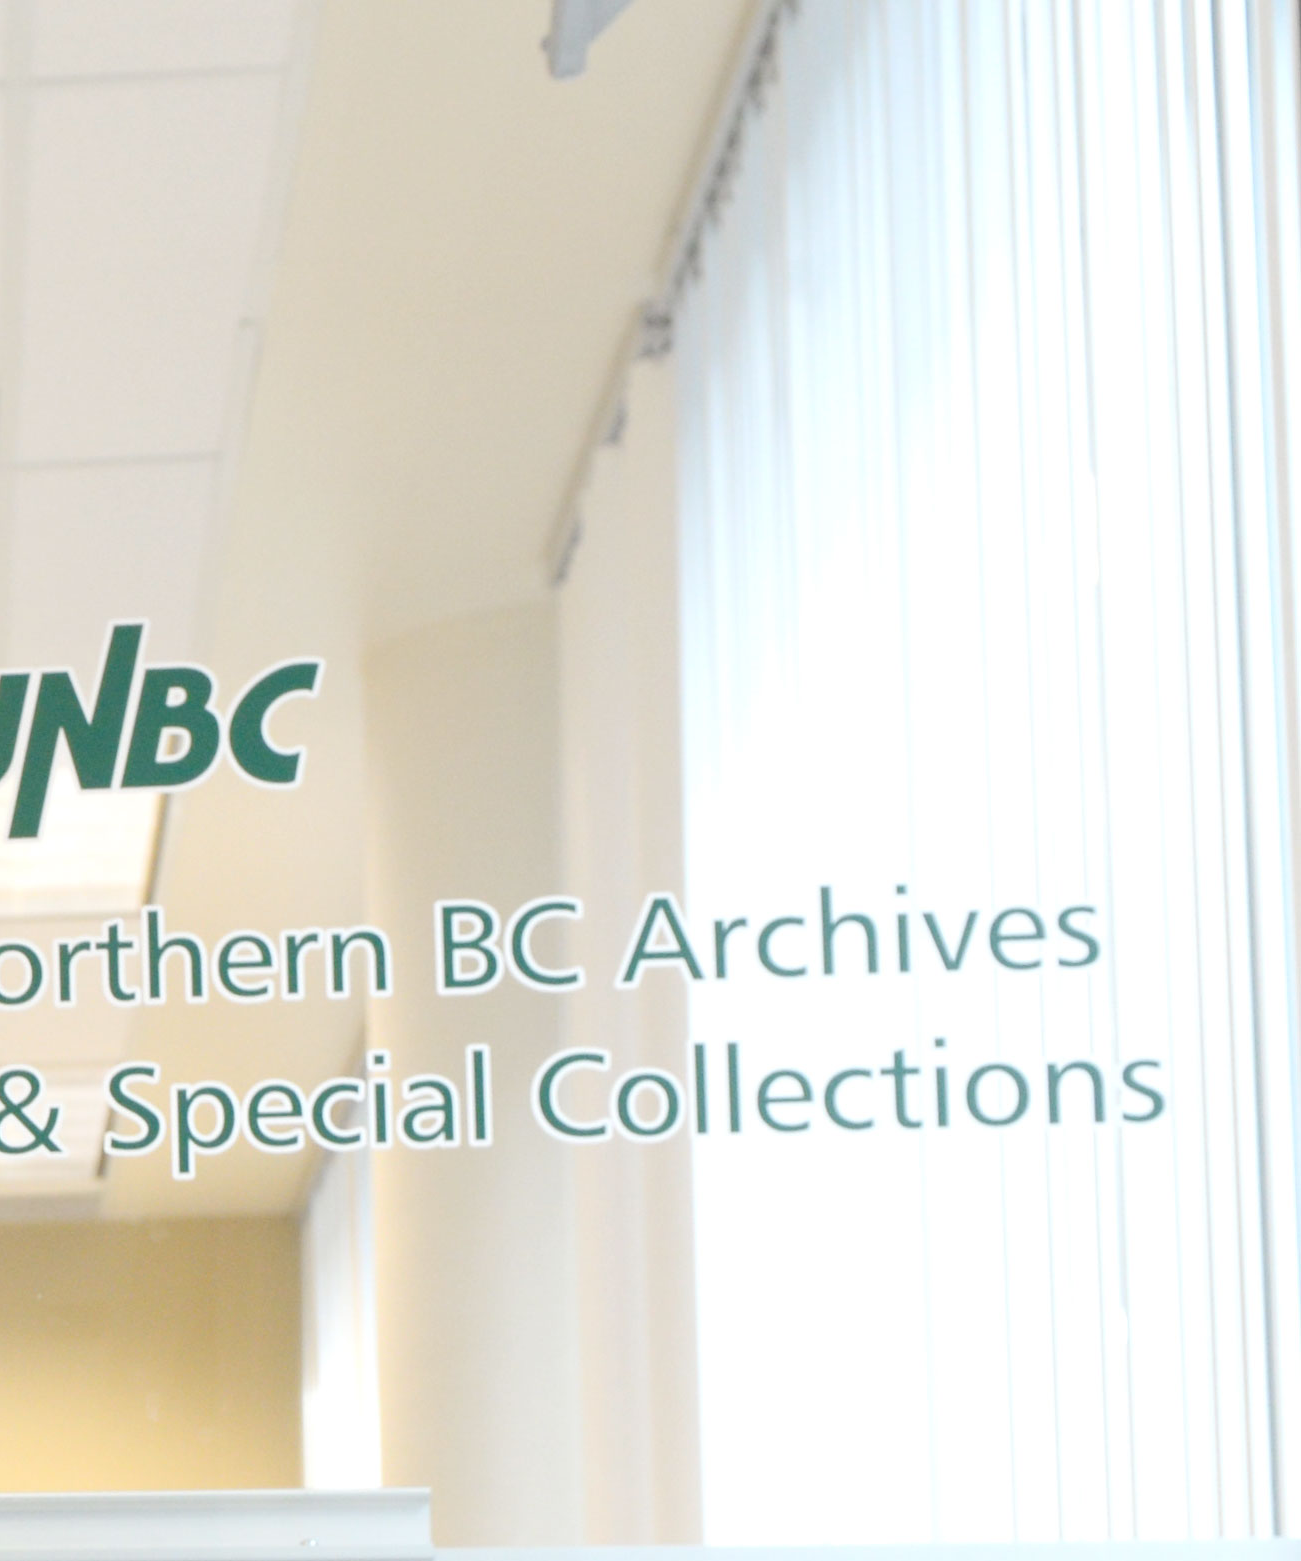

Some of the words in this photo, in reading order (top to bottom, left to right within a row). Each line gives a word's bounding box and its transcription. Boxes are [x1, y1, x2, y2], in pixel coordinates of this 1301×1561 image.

[440, 902, 581, 990] BC
[622, 884, 1103, 985] Archives
[107, 1049, 489, 1174] Special
[537, 1041, 1167, 1138] Collections
